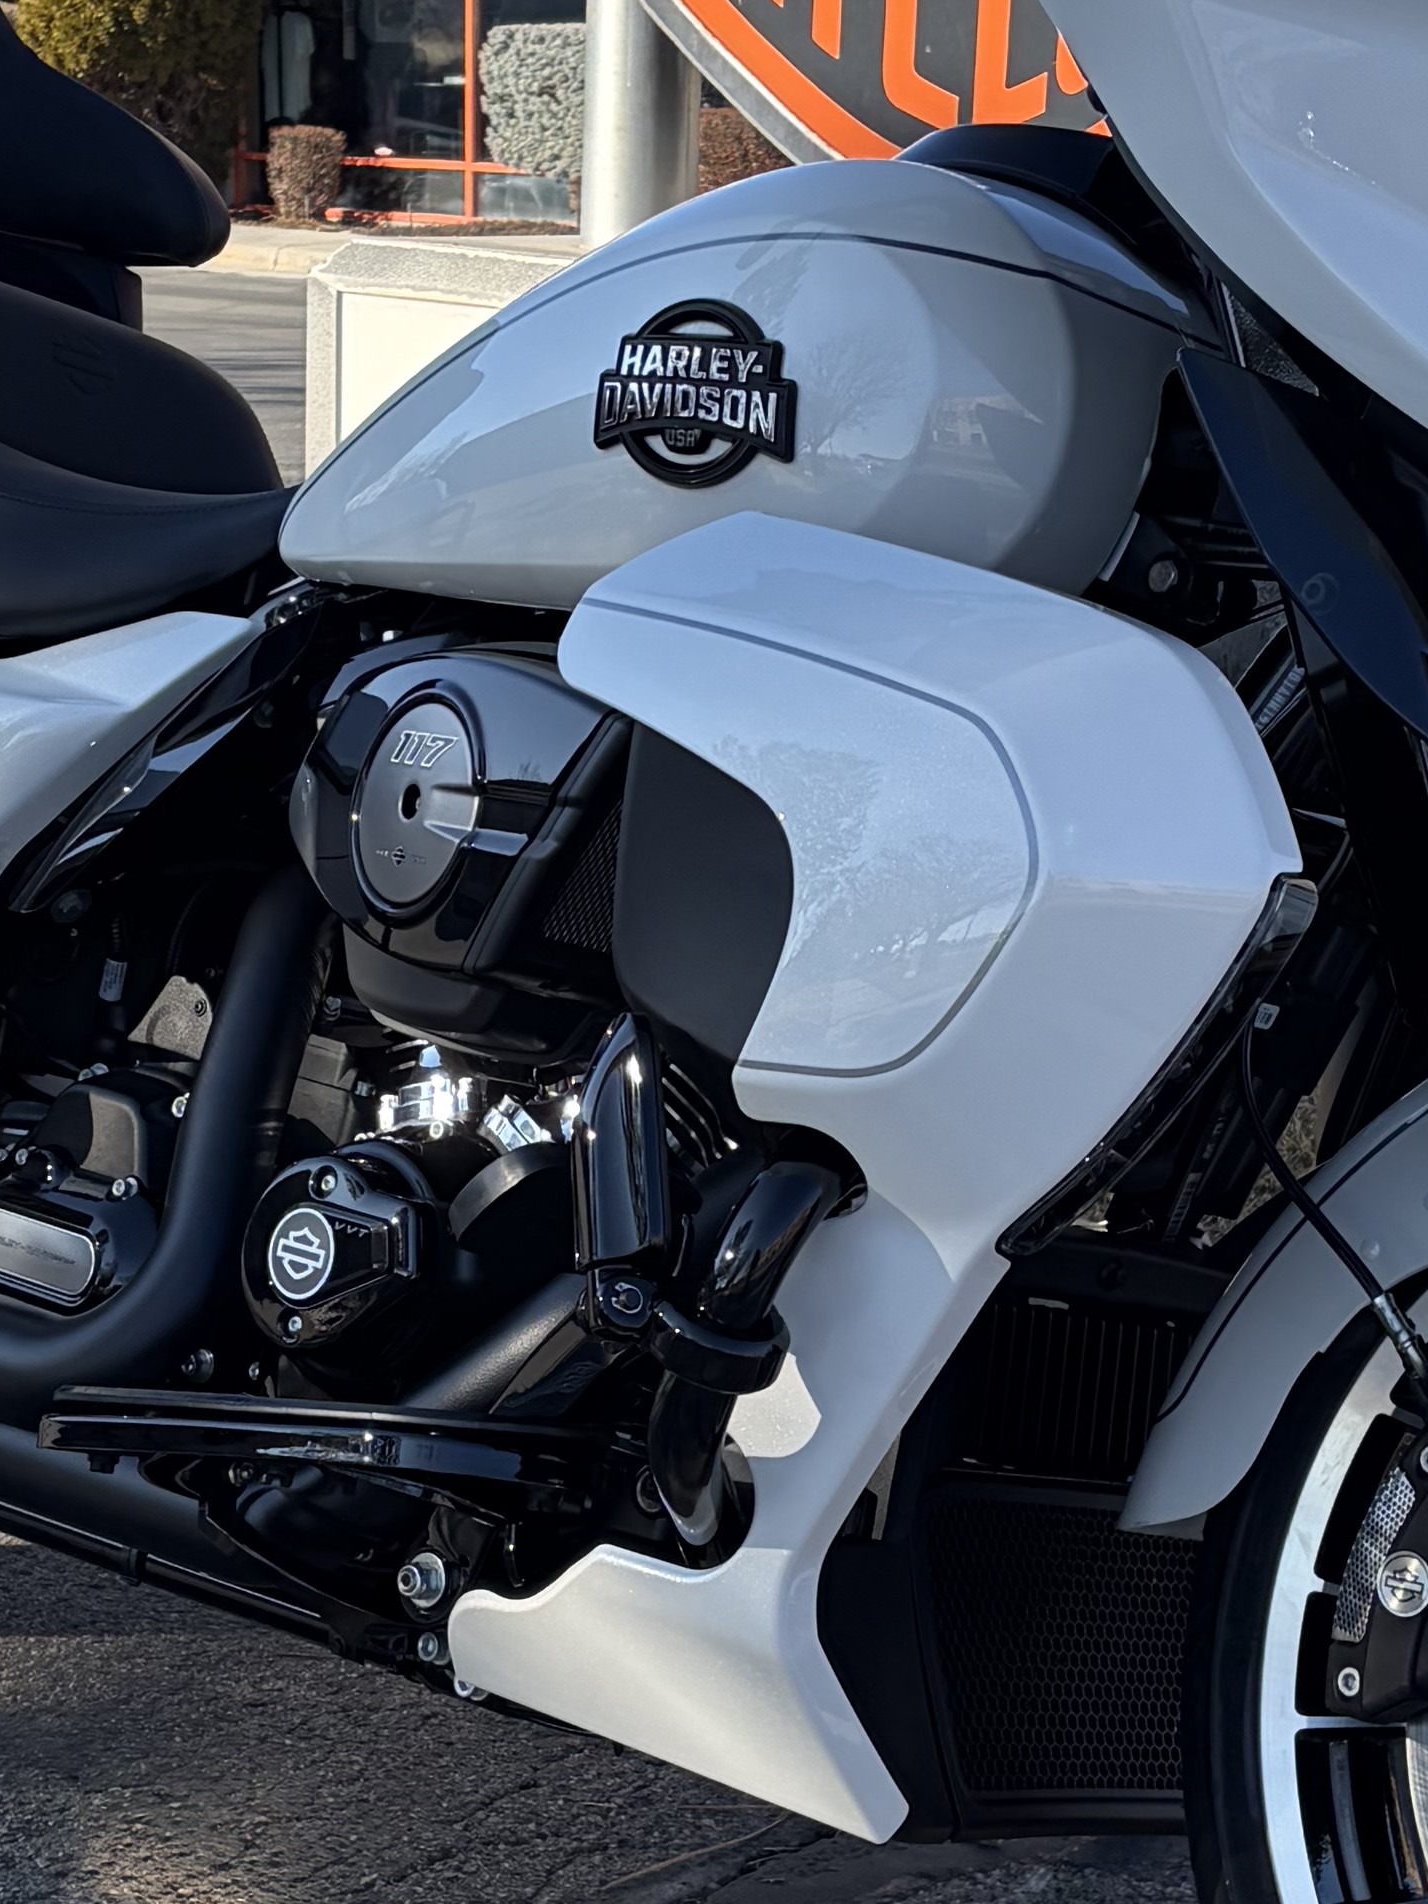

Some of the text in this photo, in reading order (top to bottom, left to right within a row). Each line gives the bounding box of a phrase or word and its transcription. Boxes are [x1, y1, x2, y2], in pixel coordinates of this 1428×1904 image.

[620, 343, 764, 383] HARLEY-
[600, 381, 778, 443] DAVIDSON
[664, 428, 695, 447] USA
[390, 729, 460, 768] 117
[335, 1221, 371, 1238] VVT
